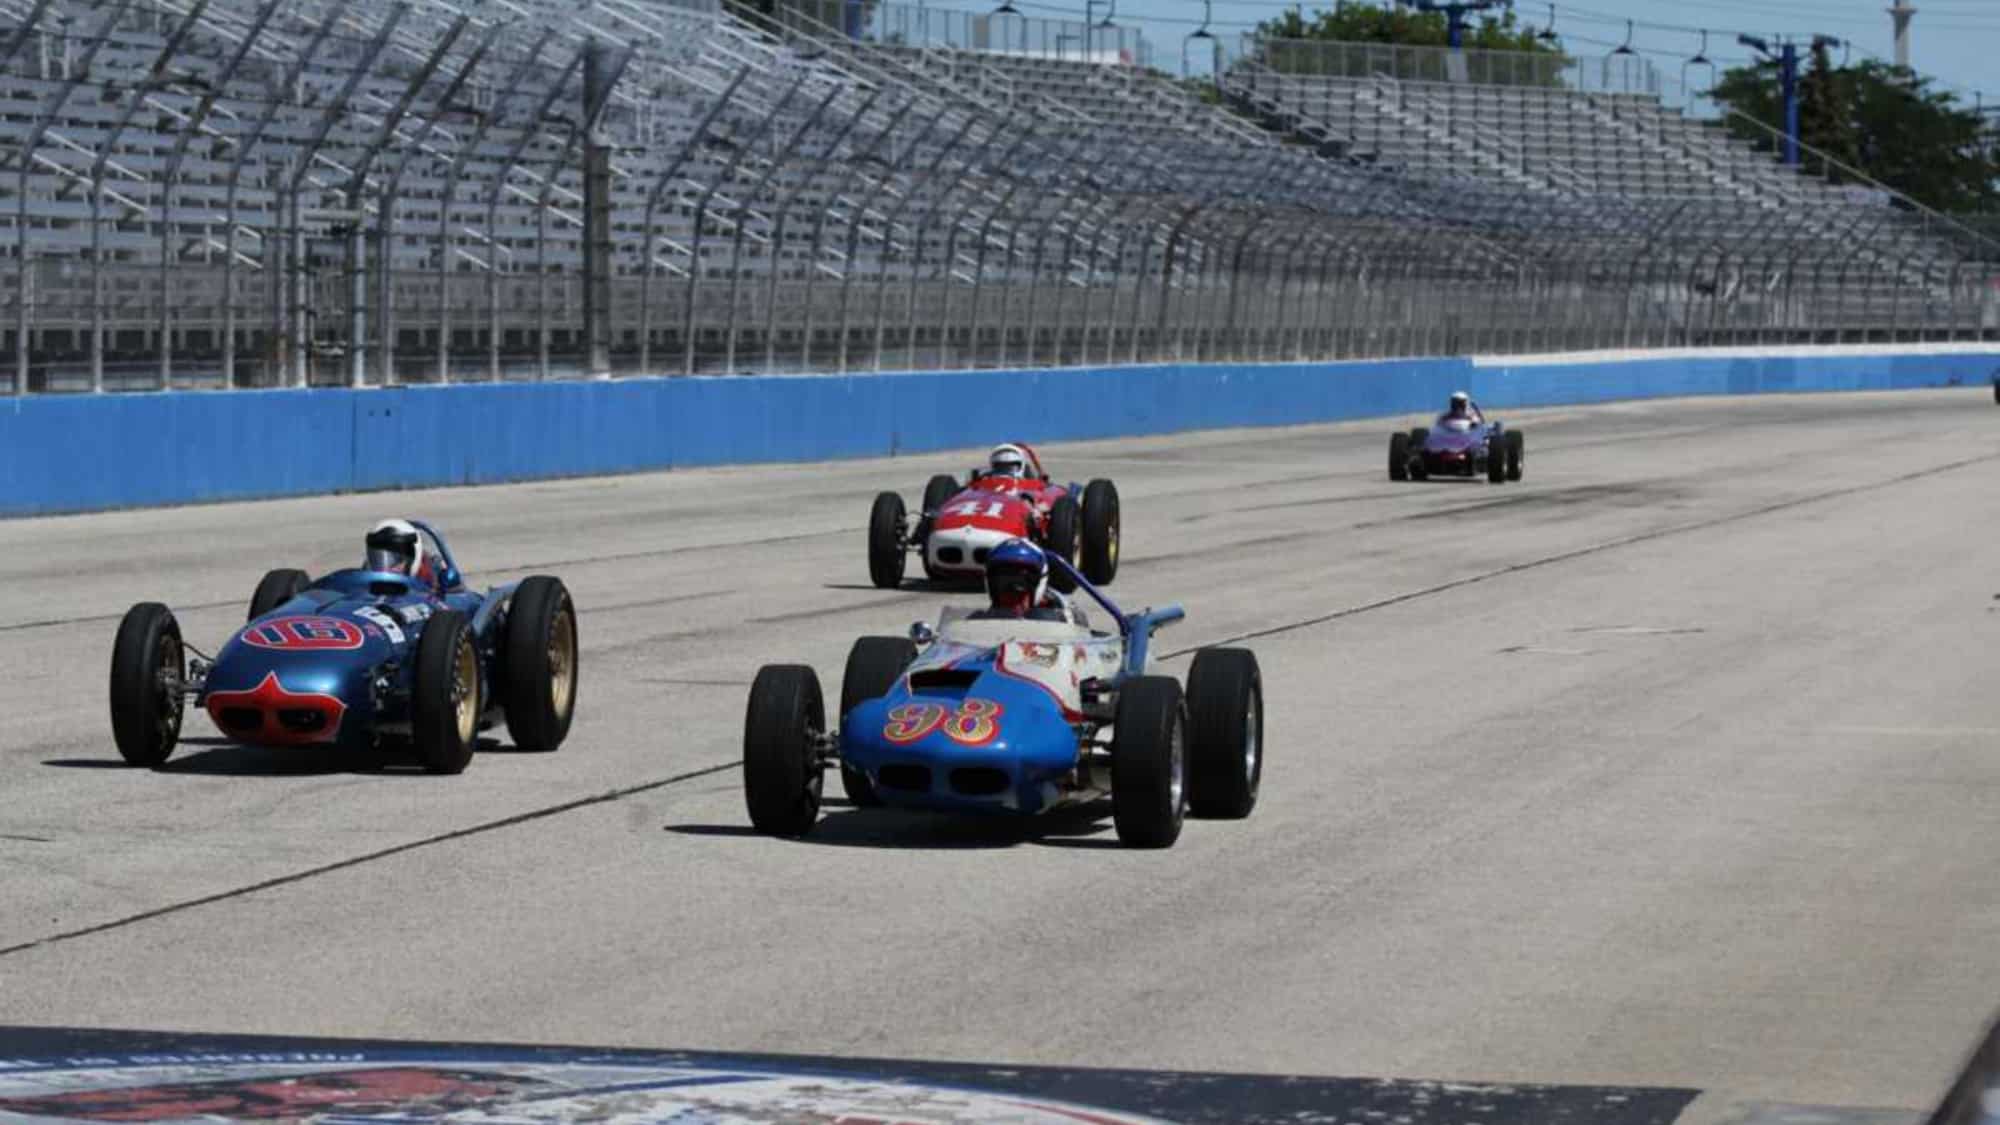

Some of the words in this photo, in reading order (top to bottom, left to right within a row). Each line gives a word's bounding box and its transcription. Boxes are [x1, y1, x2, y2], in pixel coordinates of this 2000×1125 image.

[943, 500, 1004, 519] 41
[256, 620, 351, 645] 16
[882, 698, 1003, 746] 98
